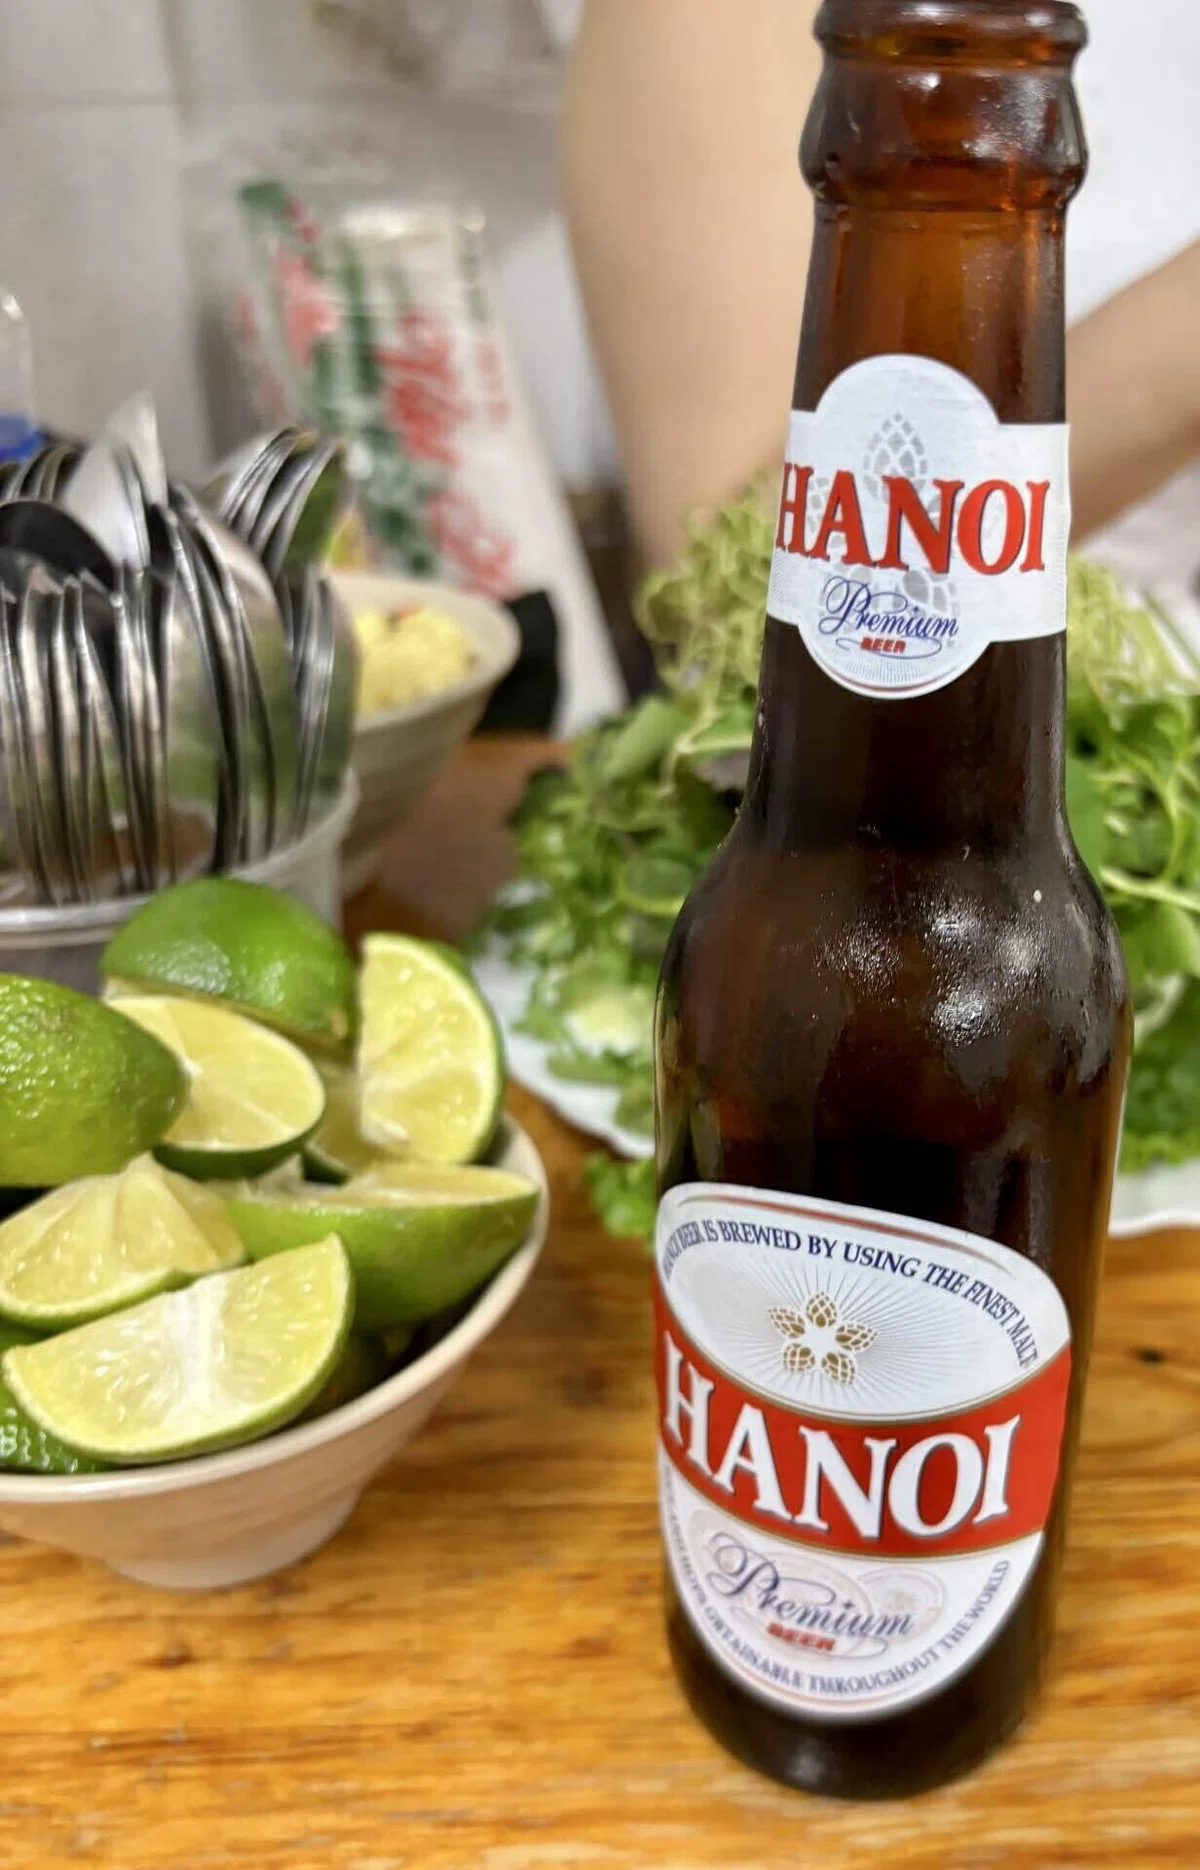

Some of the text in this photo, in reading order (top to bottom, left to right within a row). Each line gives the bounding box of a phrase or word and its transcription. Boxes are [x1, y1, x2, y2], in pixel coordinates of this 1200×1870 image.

[776, 462, 1050, 576] HANOI
[818, 575, 959, 639] Premium
[860, 637, 907, 653] BEER
[702, 1218, 719, 1242] IS
[717, 1219, 801, 1251] BREWED
[808, 1234, 839, 1259] BY
[843, 1242, 921, 1278] USING
[922, 1262, 970, 1295] THE
[961, 1279, 1020, 1328] FINEST
[1006, 1316, 1038, 1368] MALT
[664, 1329, 1021, 1540] HANOI
[706, 1531, 914, 1638] Premium
[808, 1649, 940, 1695] THROUGHOUT
[938, 1617, 973, 1650] THE
[965, 1559, 1011, 1621] WORLD
